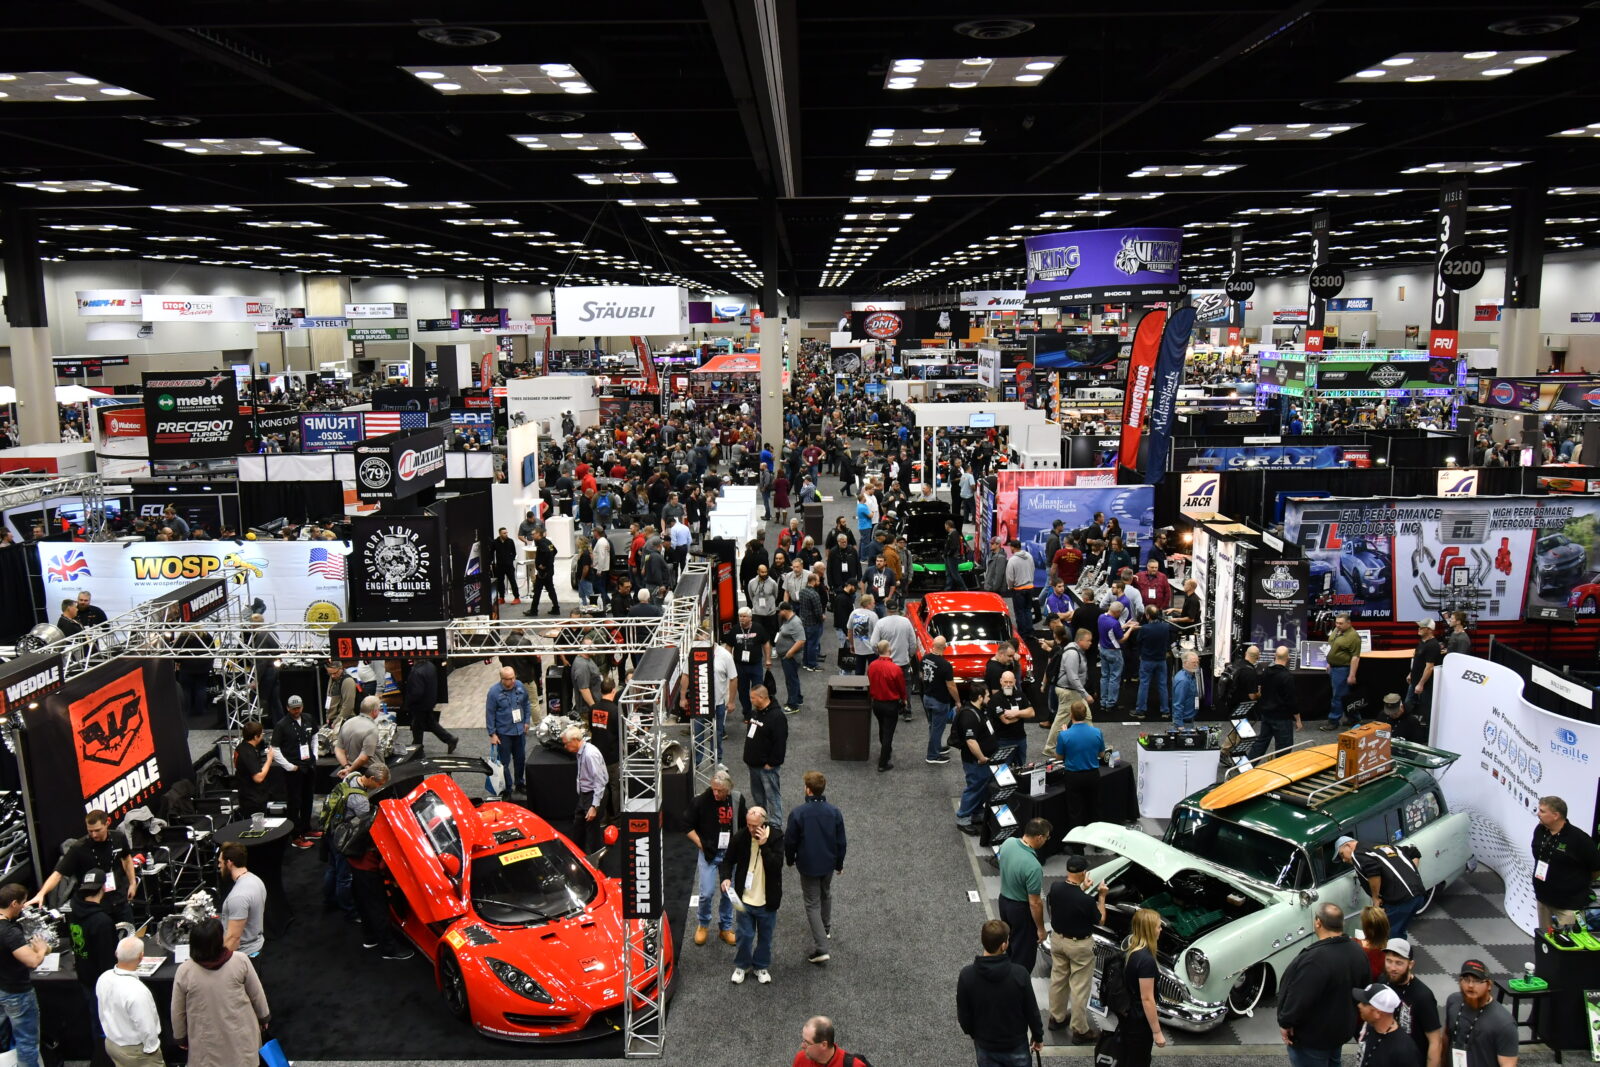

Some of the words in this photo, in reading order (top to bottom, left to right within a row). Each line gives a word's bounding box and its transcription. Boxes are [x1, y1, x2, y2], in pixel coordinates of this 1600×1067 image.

[1444, 190, 1463, 202] AISLE
[1134, 241, 1180, 264] VIKING
[1031, 246, 1081, 273] VIKING
[1038, 268, 1070, 281] PERFORMANCE
[1443, 260, 1482, 276] 3200
[1227, 282, 1253, 292] 3400
[1312, 276, 1343, 287] 3300
[1002, 298, 1026, 306] IMPA
[1074, 292, 1093, 300] ENDS
[1194, 292, 1222, 312] XS
[578, 300, 656, 323] STÄUBLI
[1197, 308, 1226, 322] POWER
[315, 319, 349, 329] STEEL-IT
[463, 313, 499, 324] McLeod
[872, 320, 894, 330] DMI
[1229, 332, 1238, 340] PRI
[1308, 336, 1321, 346] PRI
[1434, 338, 1454, 350] PRI
[146, 379, 207, 388] TURBONETICS
[176, 394, 224, 406] melett
[1128, 365, 1150, 429] Motorsports
[118, 421, 141, 429] Wabtec
[156, 419, 234, 433] PRECISION
[282, 415, 299, 427] OVER
[1227, 455, 1318, 467] GRAF
[366, 467, 384, 480] 79
[1027, 497, 1077, 511] Motorsports
[1183, 496, 1212, 508] ARCR
[1340, 508, 1361, 522] ETL
[1362, 508, 1444, 521] PERFORMANCE
[1492, 508, 1512, 517] HIGH
[1512, 506, 1574, 517] PERFORMANCE
[1337, 522, 1398, 537] PRODUCTS,
[1489, 518, 1546, 529] INTERCOOLER
[1545, 518, 1566, 528] KITS
[388, 525, 419, 543] YOUR
[364, 529, 386, 580] SUPPORT
[131, 555, 221, 581] WOSP
[414, 544, 430, 580] LOCAL
[365, 581, 395, 590] ENGINE
[397, 581, 431, 590] BUILDER
[1262, 579, 1300, 590] VIKING
[188, 585, 225, 614] WEDDLE
[317, 612, 330, 620] 25
[1361, 609, 1372, 617] AIR
[1373, 609, 1391, 617] FLOW
[1575, 606, 1597, 615] LAMPS
[355, 635, 440, 652] WEDDLE
[358, 650, 441, 658] INDUSTRIES
[6, 665, 60, 703] WEDDLE
[697, 662, 710, 716] WEDDLE
[1492, 706, 1501, 719] We
[1501, 712, 1514, 731] Power
[1550, 739, 1590, 762] braille
[1481, 746, 1493, 761] And
[1493, 753, 1516, 783] Everything
[84, 756, 161, 815] WEDDLE
[106, 780, 163, 826] DUSTRIES
[503, 848, 538, 864] PIRELLI
[634, 836, 651, 915] WEDDLE
